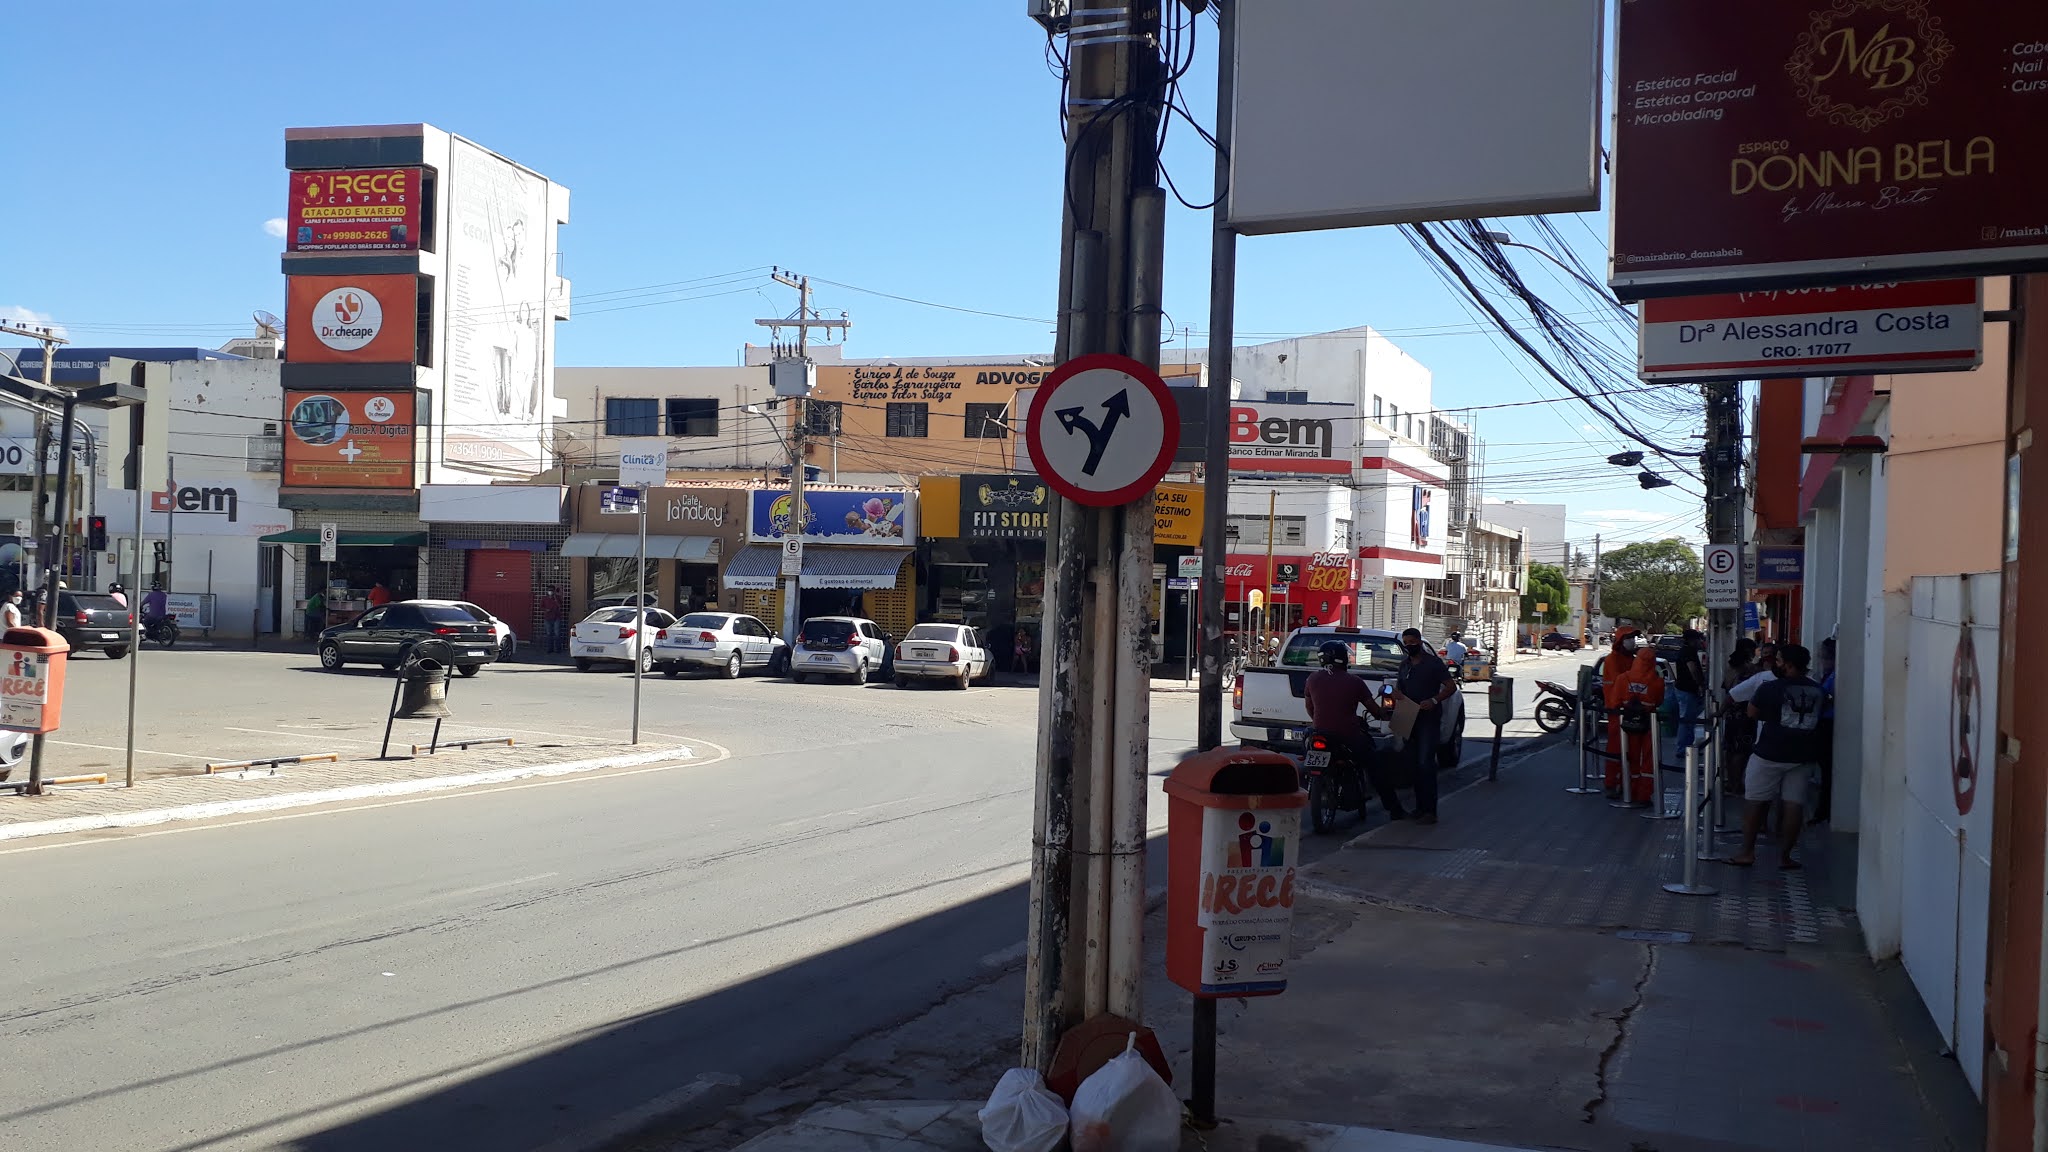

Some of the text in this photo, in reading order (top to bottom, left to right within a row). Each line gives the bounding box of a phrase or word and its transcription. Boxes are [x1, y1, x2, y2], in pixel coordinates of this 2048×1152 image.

[2012, 59, 2043, 74] Nail
[1635, 70, 1737, 92] Estética Facial
[2012, 80, 2048, 92] Curs
[1635, 84, 1756, 109] Estética Corporal
[1634, 107, 1724, 126] Microblading
[1739, 139, 1789, 155] ESPAÇO
[1731, 136, 1995, 195] DONNA BELA
[329, 170, 406, 194] IRECÊ
[328, 195, 405, 204] CAPAS
[1781, 187, 1938, 223] by Maira Brito
[303, 206, 406, 217] ATACADO E VAREJO
[1722, 316, 1859, 342] Alessandra
[1875, 310, 1950, 333] Costa
[1761, 342, 1852, 358] CRO: 17077
[854, 367, 891, 379] Eurico
[905, 368, 919, 379] de
[923, 367, 956, 382] Souza
[853, 389, 888, 400] Eurico
[920, 388, 952, 402] Souza
[379, 424, 409, 437] Digital
[1229, 407, 1333, 458] Bem
[622, 454, 655, 465] Clínica
[1255, 448, 1283, 457] Edmar
[1285, 448, 1319, 458] Miranda
[683, 494, 699, 506] Café
[1170, 493, 1188, 503] SEU
[974, 511, 997, 527] FIT
[972, 529, 1048, 537] SUPLEMENTO
[1311, 552, 1350, 568] PASTEL
[1716, 555, 1726, 569] E
[1308, 567, 1350, 592] BOB
[0, 678, 45, 697] RECÊ
[1201, 867, 1297, 915] IRECÊ
